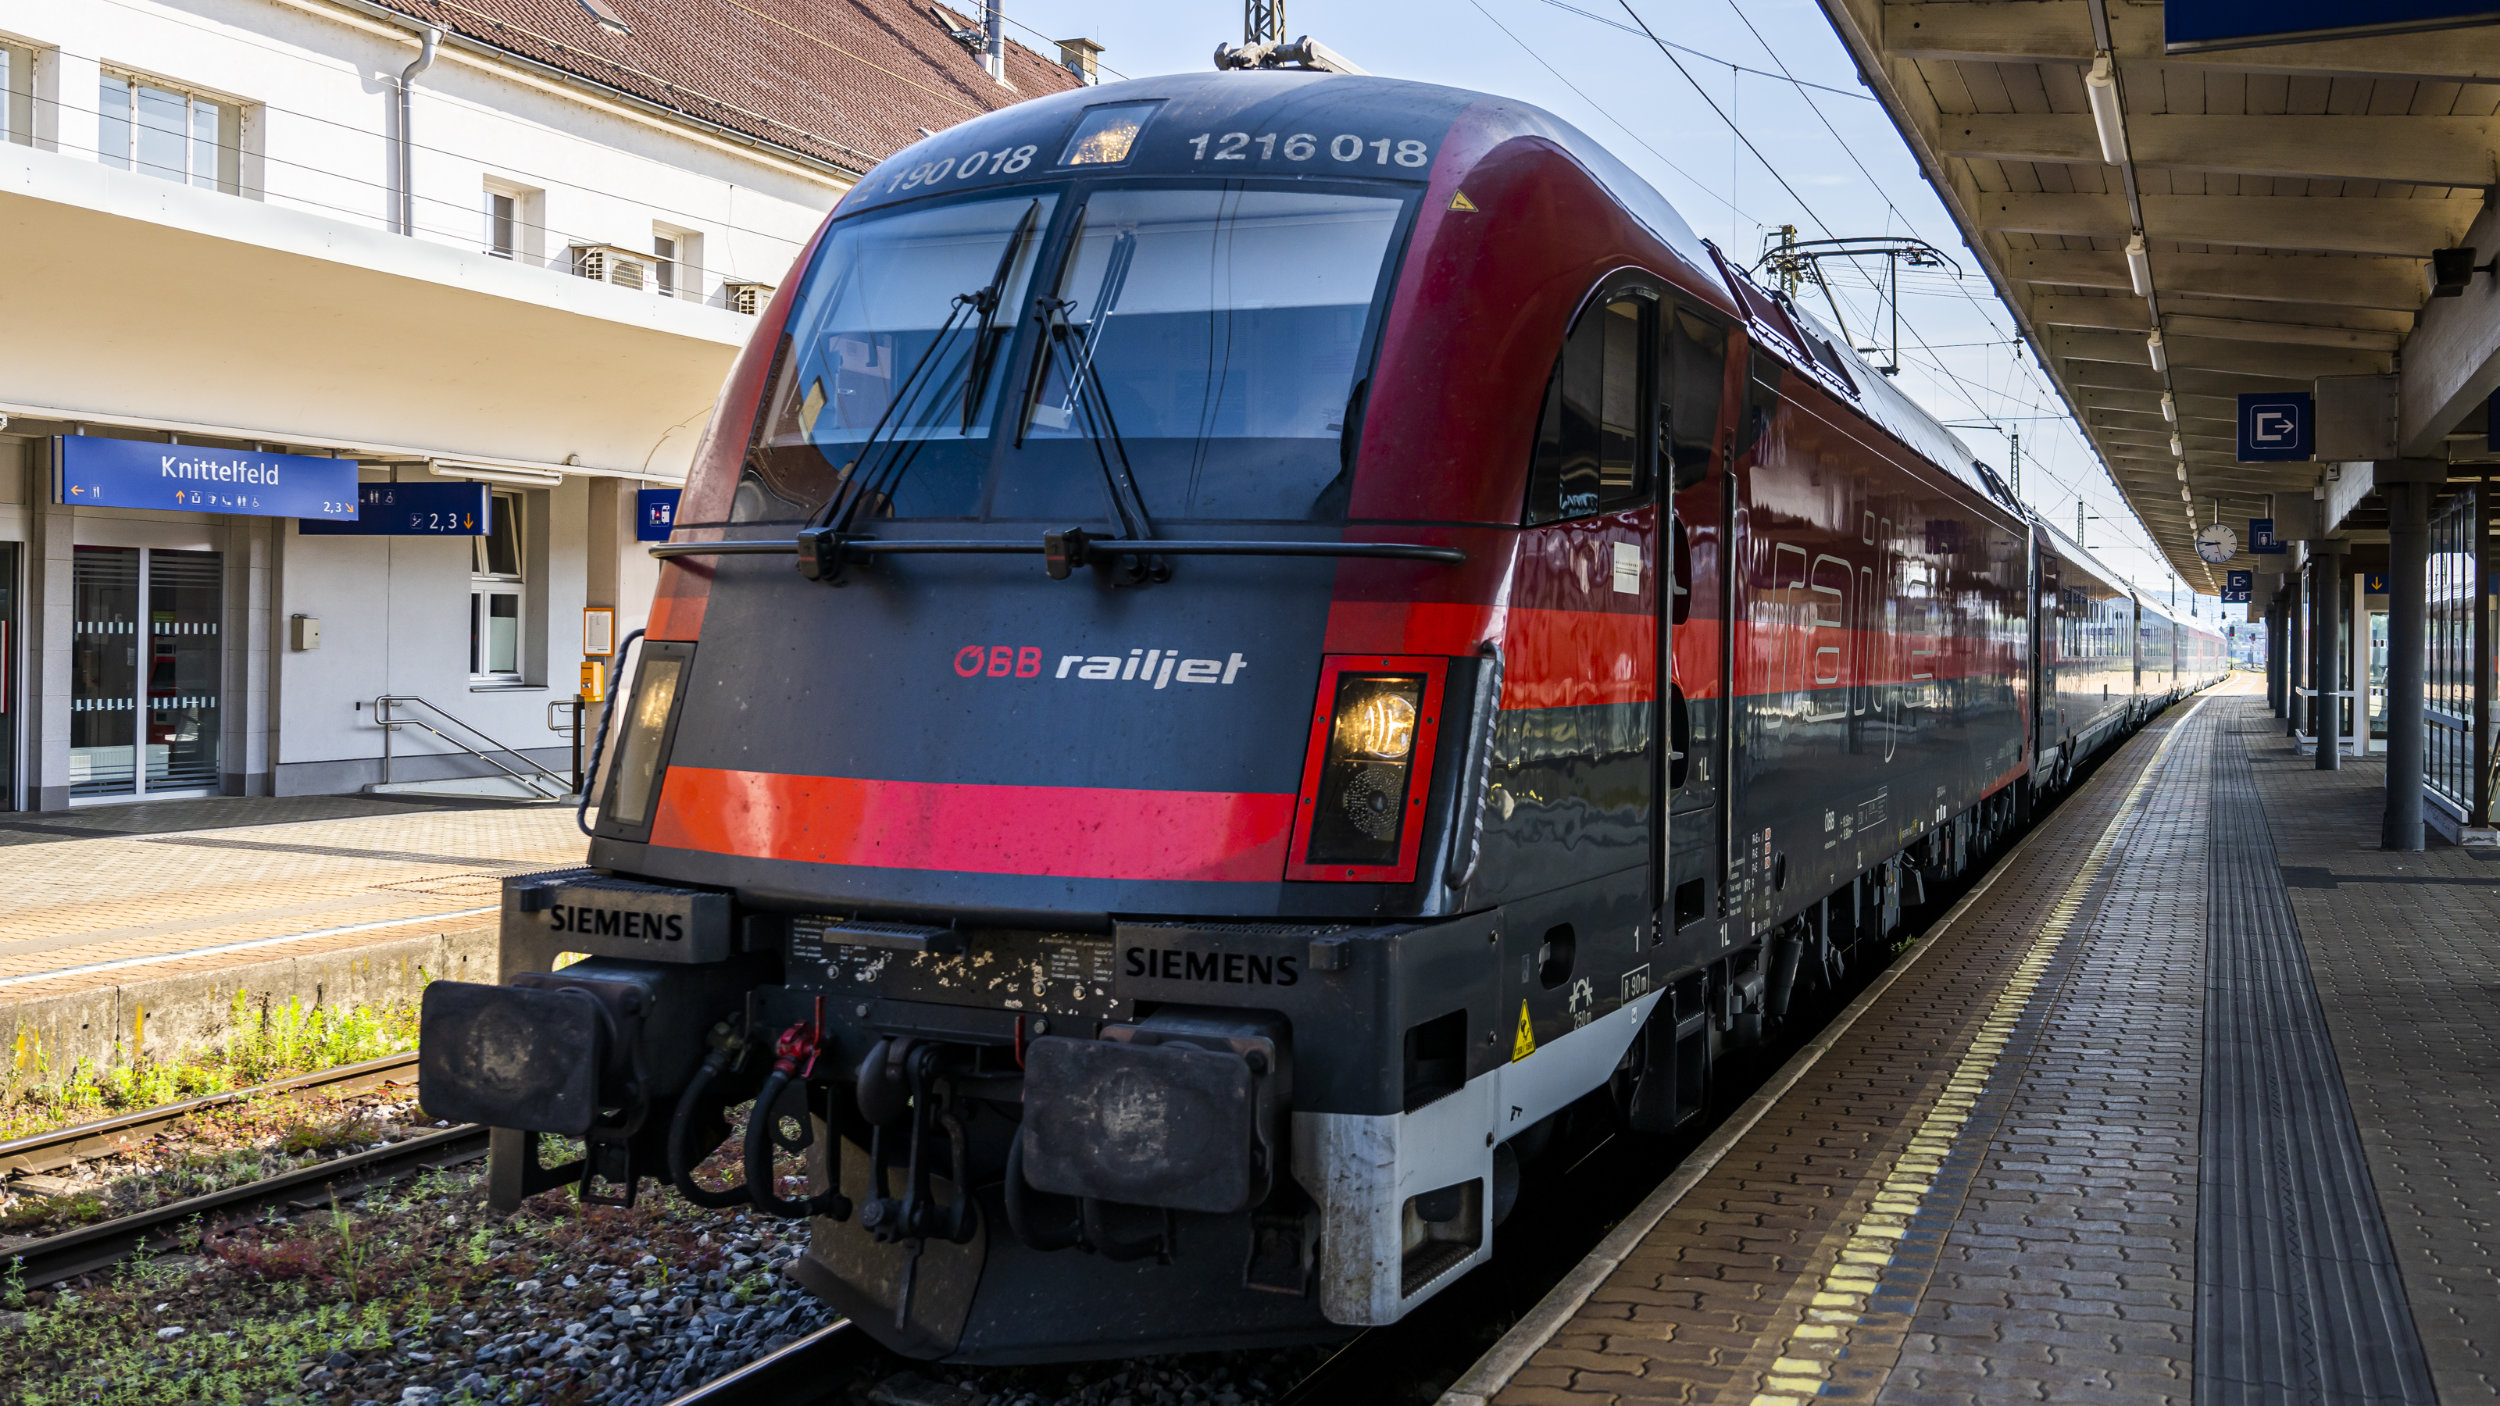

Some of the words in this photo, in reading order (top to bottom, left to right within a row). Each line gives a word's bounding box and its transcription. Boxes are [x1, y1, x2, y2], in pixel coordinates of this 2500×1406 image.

[1188, 132, 1318, 161] 1216
[1330, 134, 1428, 168] 018
[886, 157, 956, 194] 190
[956, 144, 1039, 180] 018
[161, 456, 280, 486] Knittelfeld
[323, 501, 343, 514] 2,3
[429, 513, 458, 533] 2,3
[2238, 591, 2246, 601] B
[954, 645, 1043, 678] ÖBB
[1055, 648, 1248, 690] railjet
[1698, 756, 1710, 782] 1L
[550, 903, 684, 942] SIEMENS
[1719, 922, 1731, 948] 1L
[1633, 925, 1640, 953] 1
[1126, 946, 1299, 987] SIEMENS
[1624, 979, 1629, 1001] R
